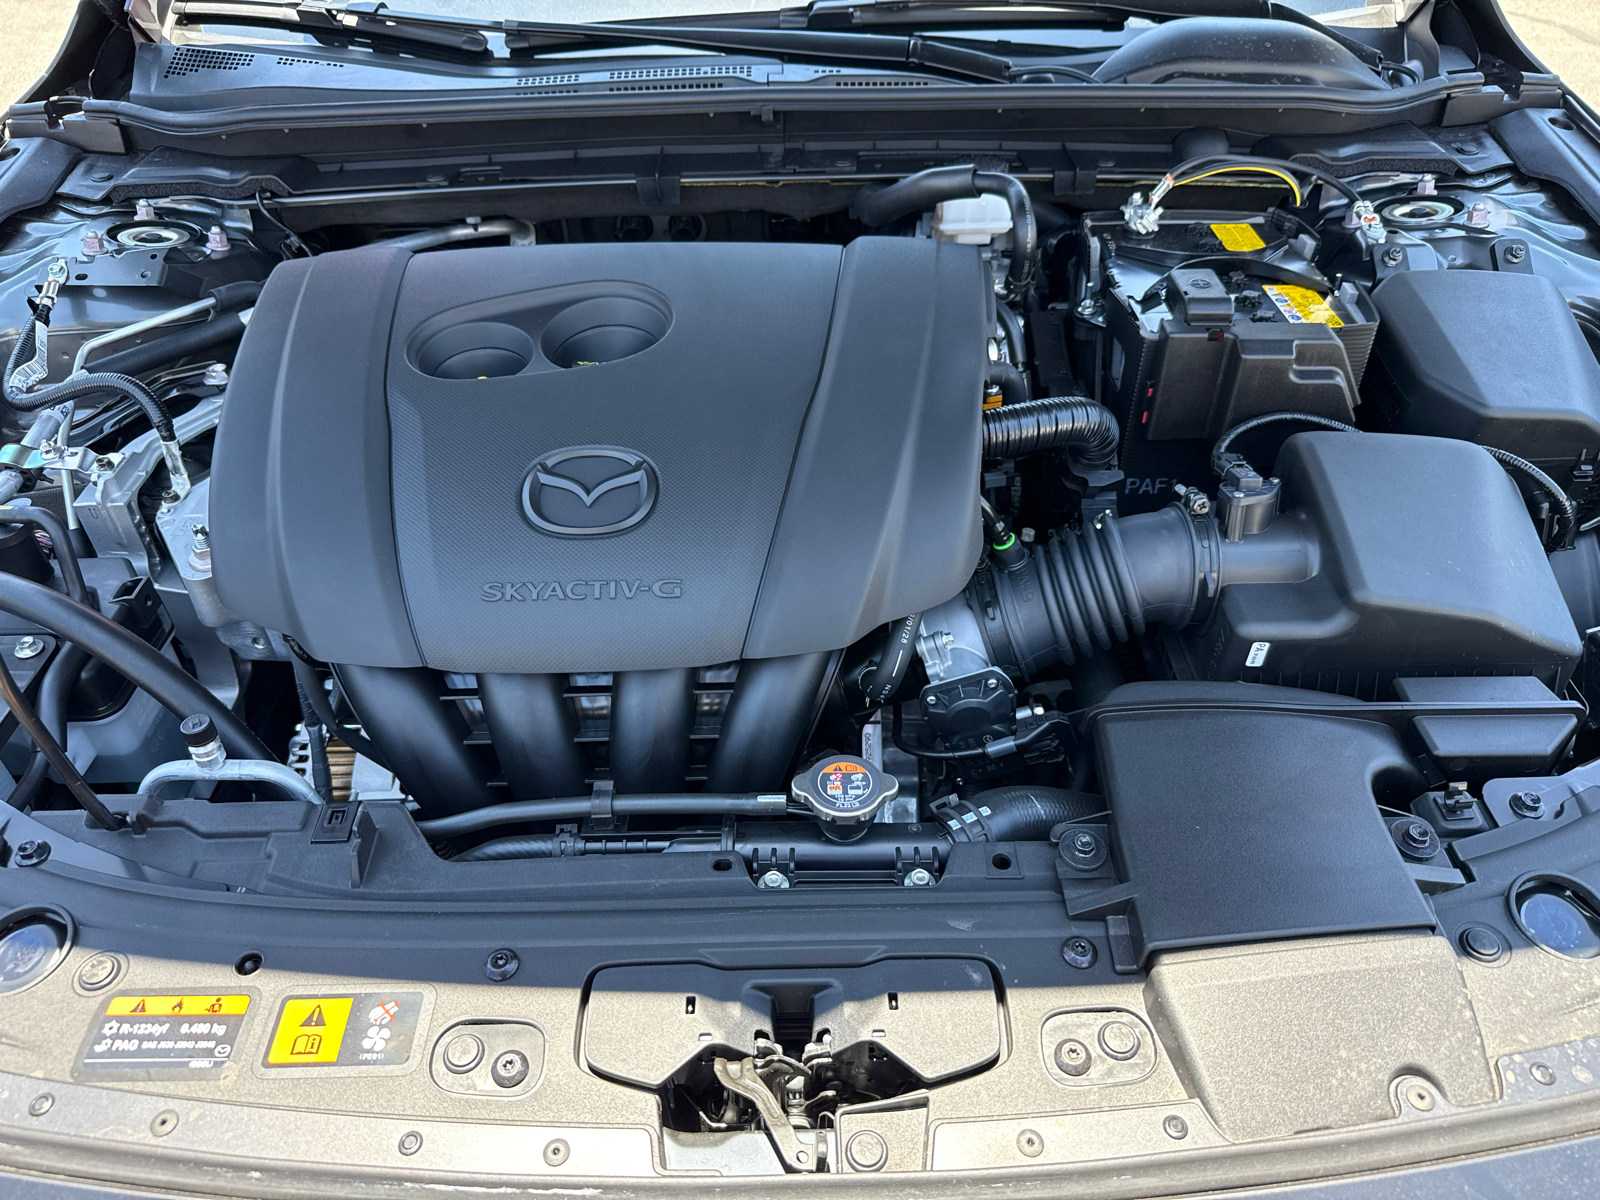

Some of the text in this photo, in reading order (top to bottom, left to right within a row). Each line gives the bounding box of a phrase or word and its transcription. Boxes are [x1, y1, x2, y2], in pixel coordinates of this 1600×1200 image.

[482, 579, 682, 602] SKYACTIV-G
[190, 718, 202, 730] H
[211, 1023, 227, 1036] kg
[112, 1039, 139, 1051] PAG
